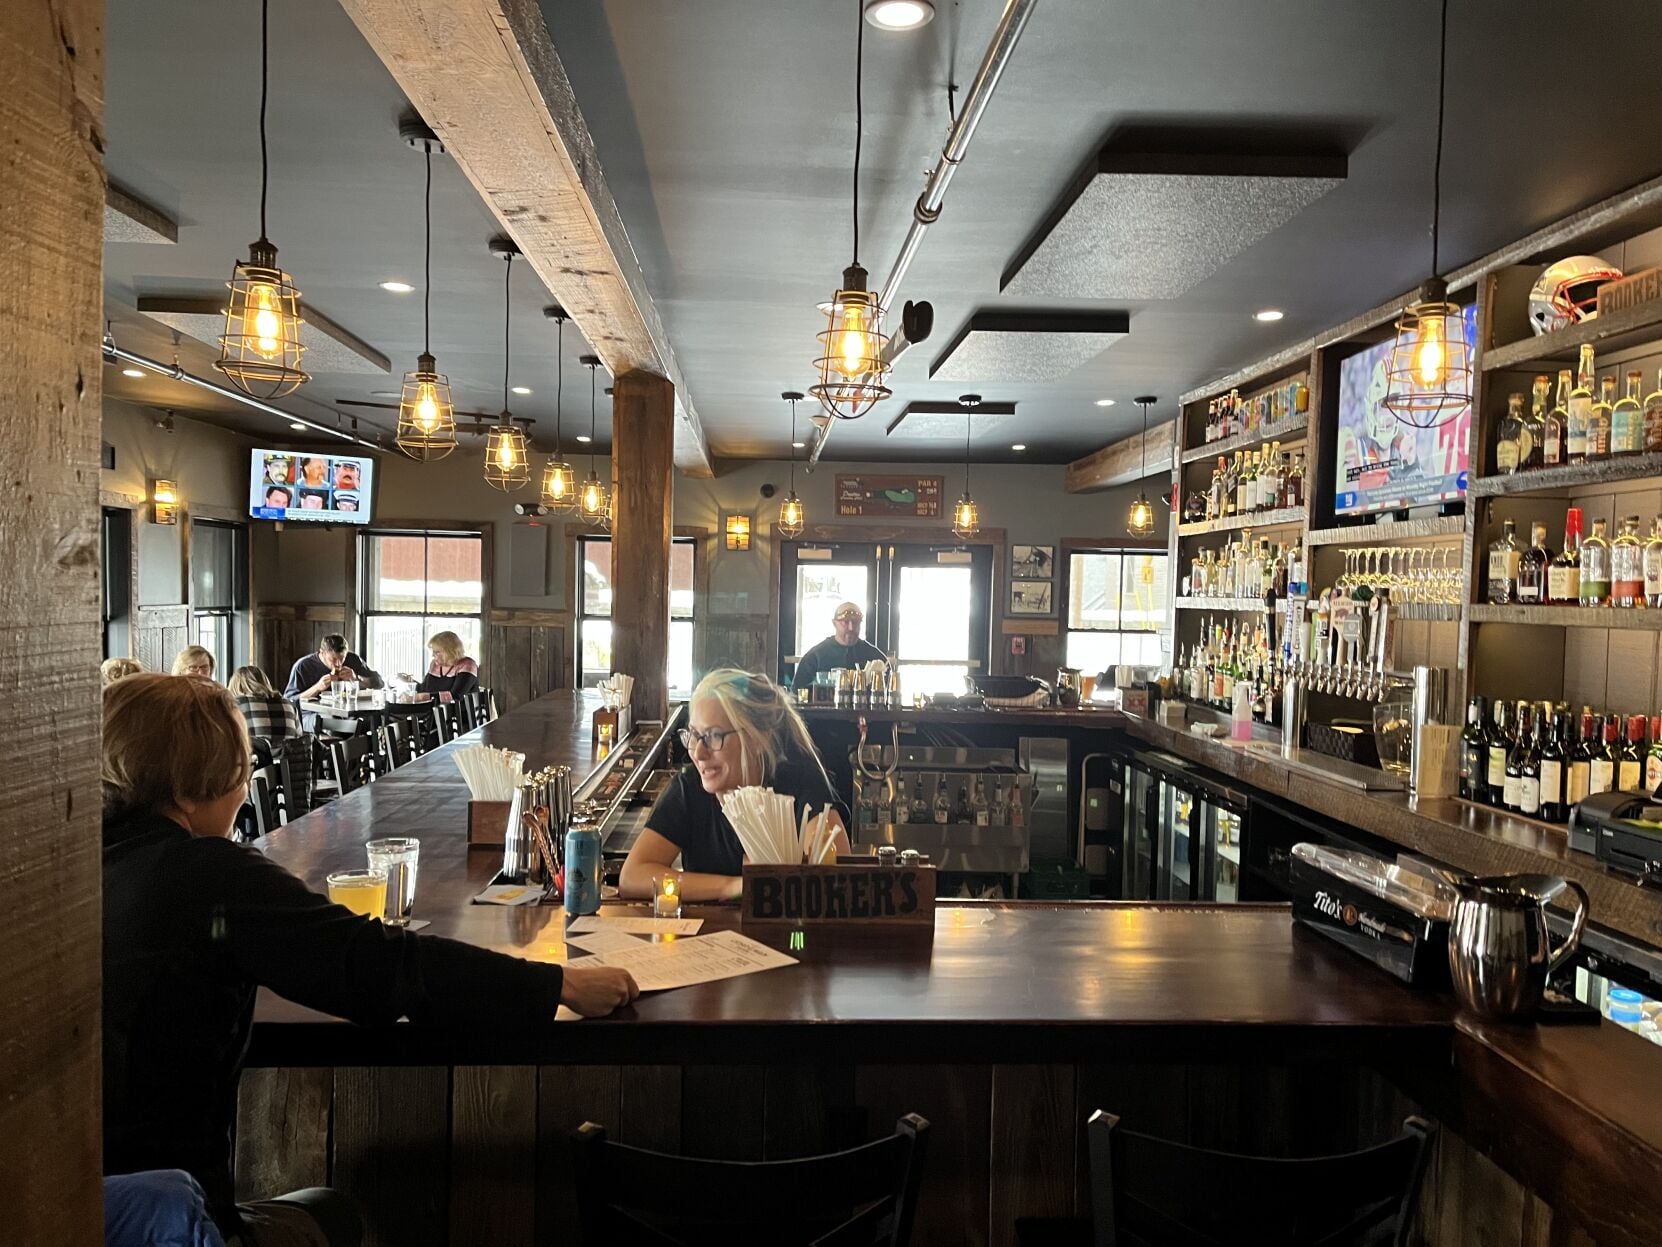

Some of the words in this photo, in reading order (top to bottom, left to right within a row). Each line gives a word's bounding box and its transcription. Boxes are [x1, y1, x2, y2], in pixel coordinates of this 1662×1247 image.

[841, 505, 857, 515] Hole
[859, 506, 863, 515] 1
[752, 872, 918, 918] BOOKER'S
[1314, 891, 1342, 920] Tito's
